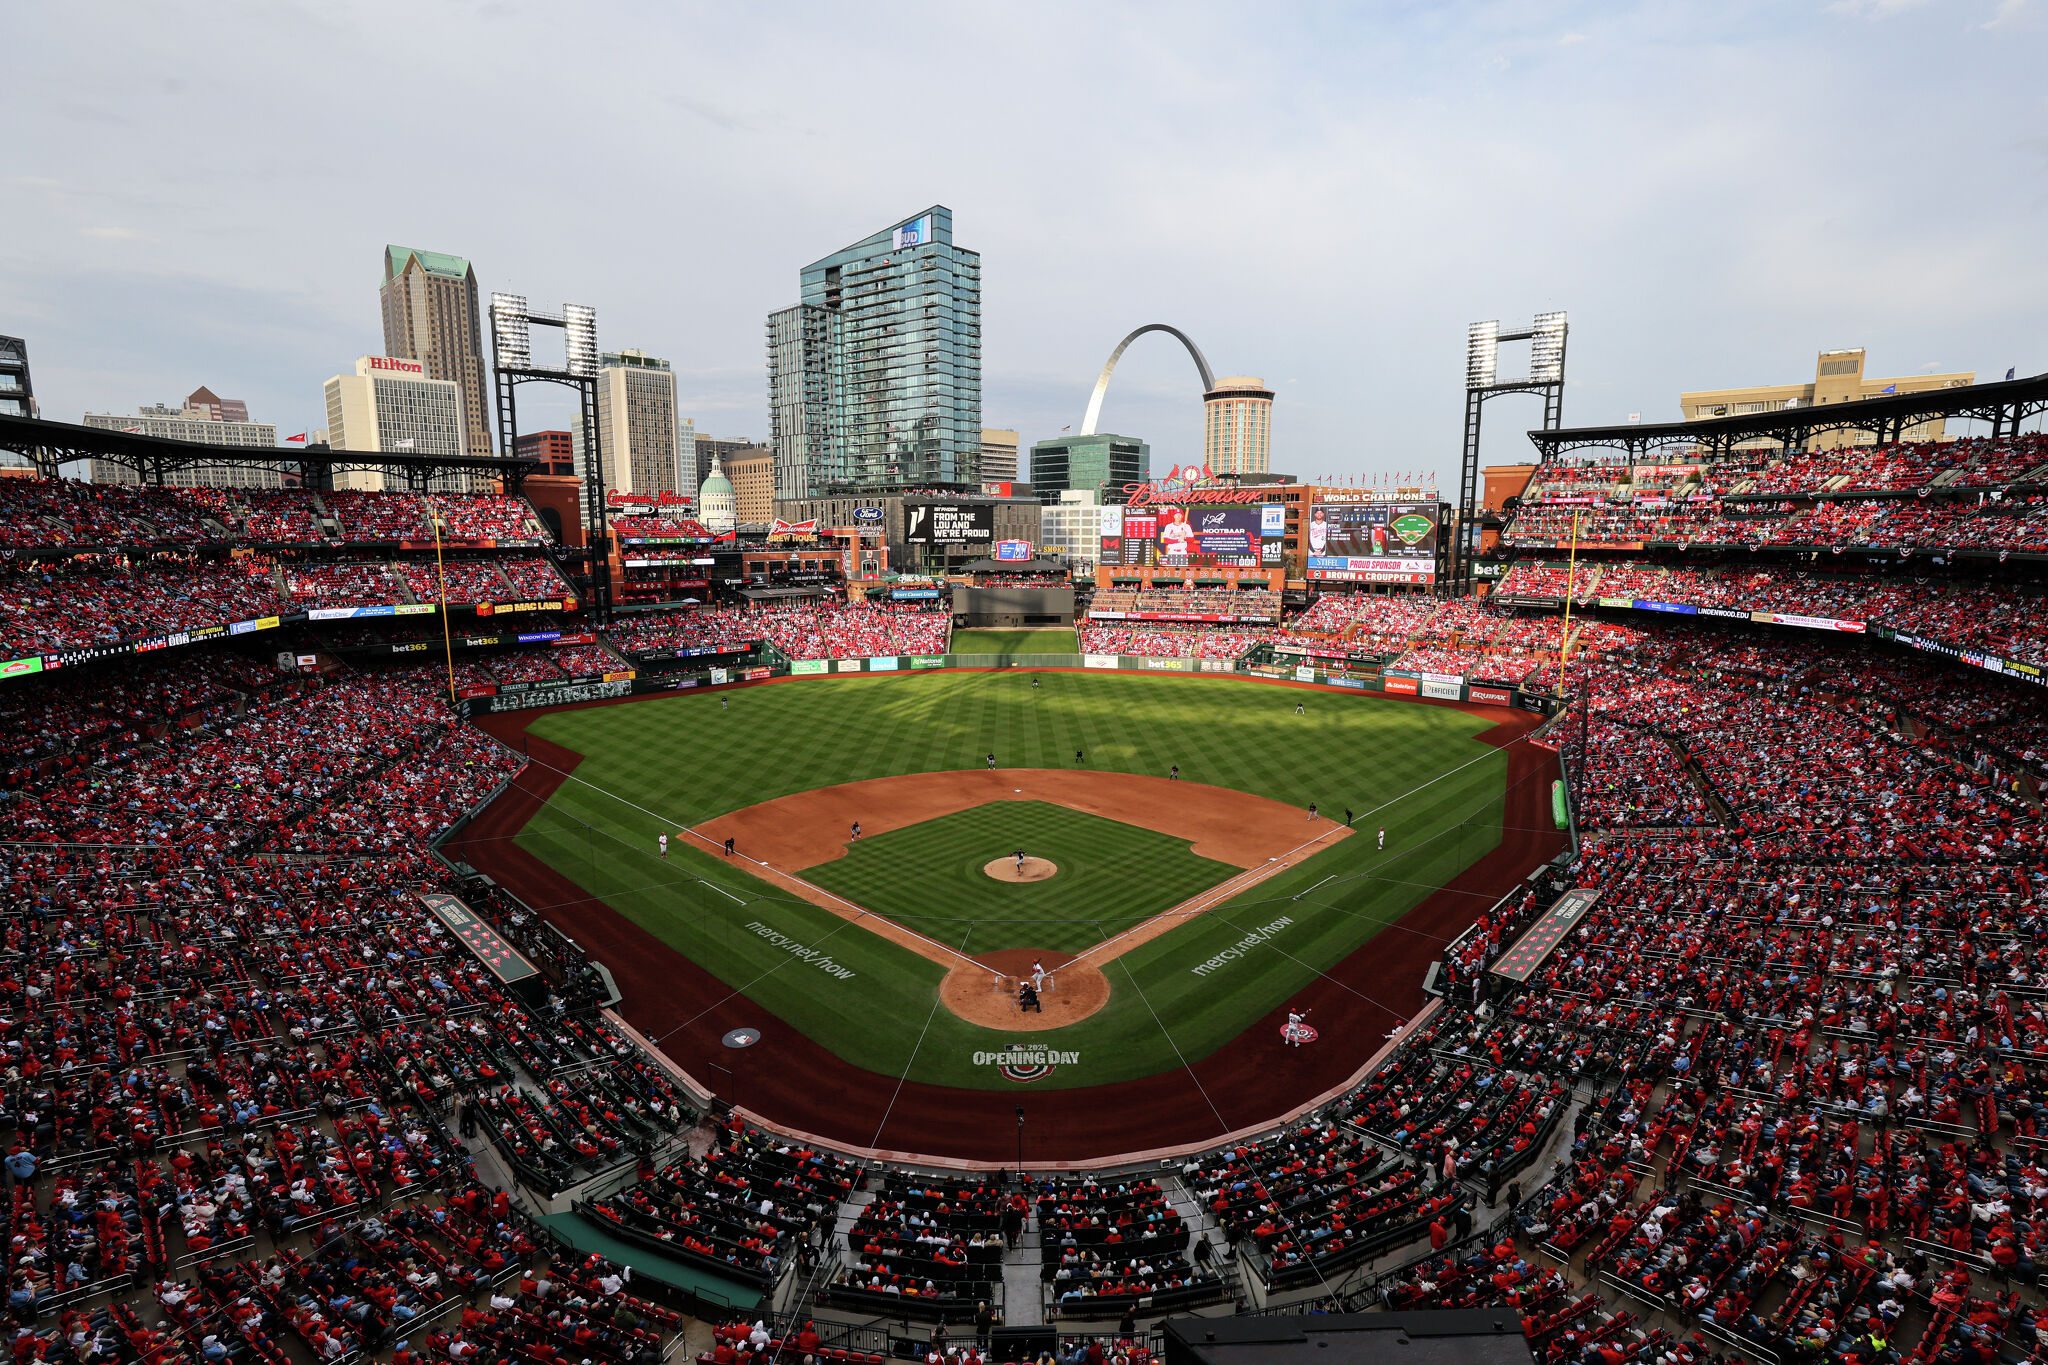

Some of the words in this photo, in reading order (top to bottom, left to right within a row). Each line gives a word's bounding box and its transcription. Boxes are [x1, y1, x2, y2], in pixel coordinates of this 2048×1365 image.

[370, 356, 422, 373] Hilton
[607, 489, 654, 506] Cardinals
[654, 489, 692, 507] Nation
[1122, 482, 1262, 506] Budweiser
[1324, 494, 1360, 502] WORLD
[1362, 493, 1426, 502] CHAMPIONS
[860, 508, 878, 518] Ford
[768, 524, 817, 534] Budweiser
[934, 521, 950, 529] LOU
[952, 521, 970, 529] AND
[934, 530, 960, 538] WE'RE
[962, 530, 990, 538] PROUD
[1262, 542, 1282, 554] stl
[1317, 558, 1338, 566] STIFEL
[1350, 560, 1370, 569] PROUD
[1372, 561, 1401, 570] SPONSOR
[1326, 572, 1356, 580] BROWN
[1366, 572, 1412, 582] CROUPPEN
[514, 602, 537, 612] MAC
[538, 602, 562, 610] LAND
[1698, 608, 1749, 619] LINDENWOOD.EDU
[467, 638, 498, 646] bet365
[392, 643, 428, 652] bet365
[1149, 660, 1182, 669] bet365
[610, 672, 630, 680] DOBBS
[1424, 685, 1458, 696] PERFICIENT
[1472, 691, 1506, 700] EQUIFAX
[745, 919, 856, 980] mercy.net/now
[1191, 914, 1294, 978] mercy.net/now
[973, 1051, 1045, 1065] OPENING
[1048, 1050, 1080, 1064] DAY
